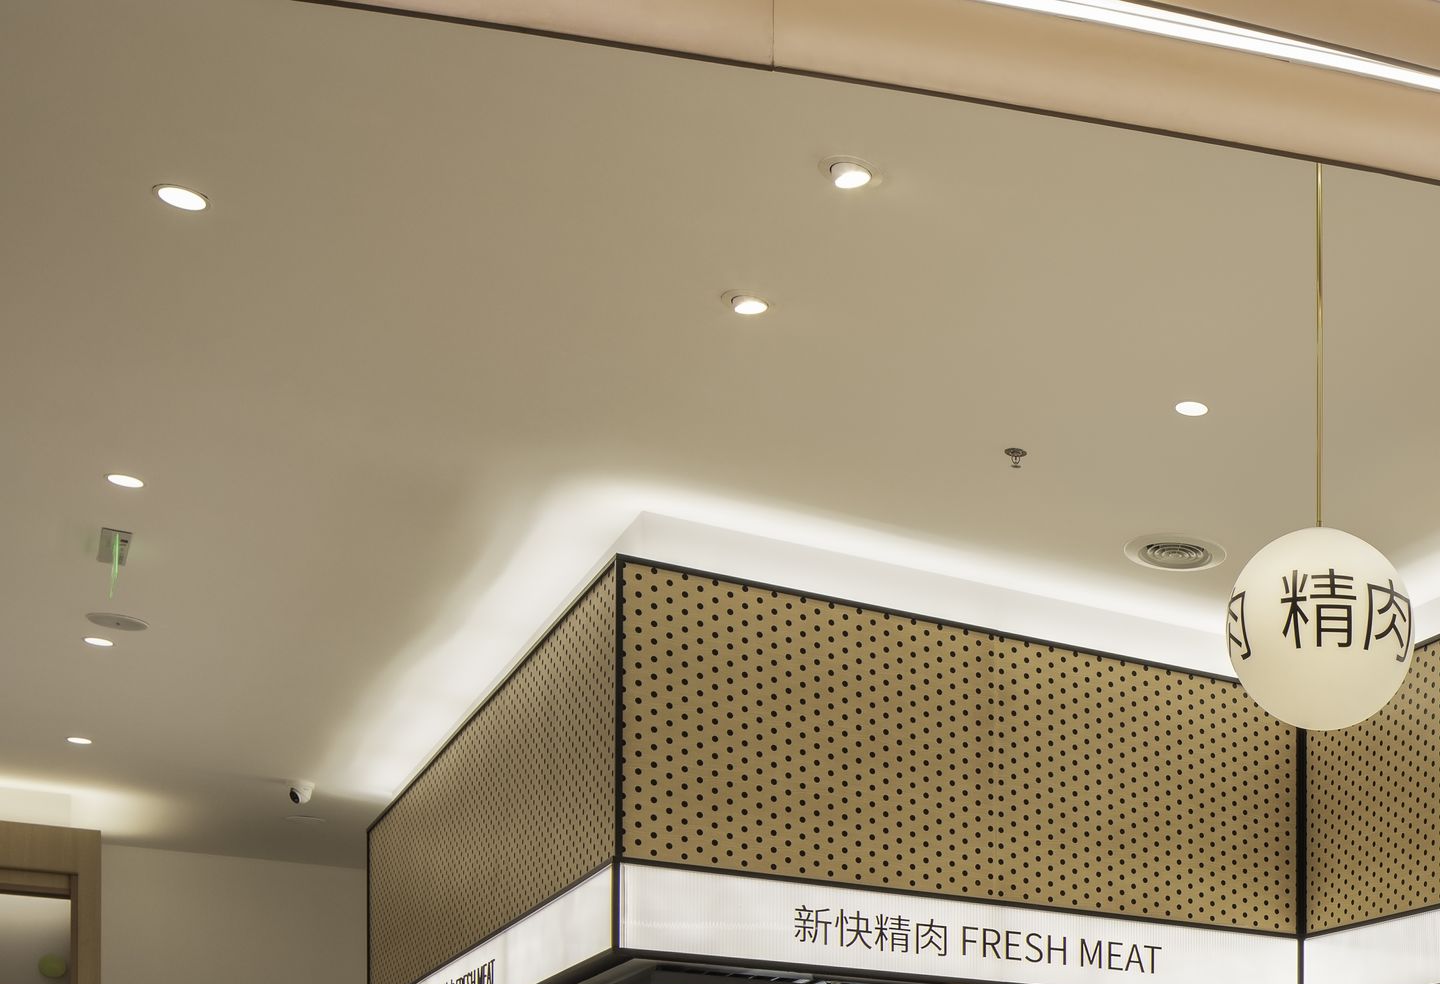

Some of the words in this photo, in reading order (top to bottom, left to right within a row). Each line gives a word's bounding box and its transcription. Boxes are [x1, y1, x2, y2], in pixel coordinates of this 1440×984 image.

[1280, 568, 1411, 663] 精肉
[793, 904, 949, 957] 新快精肉
[961, 925, 1068, 966] FRESH
[1079, 937, 1163, 975] MEAT
